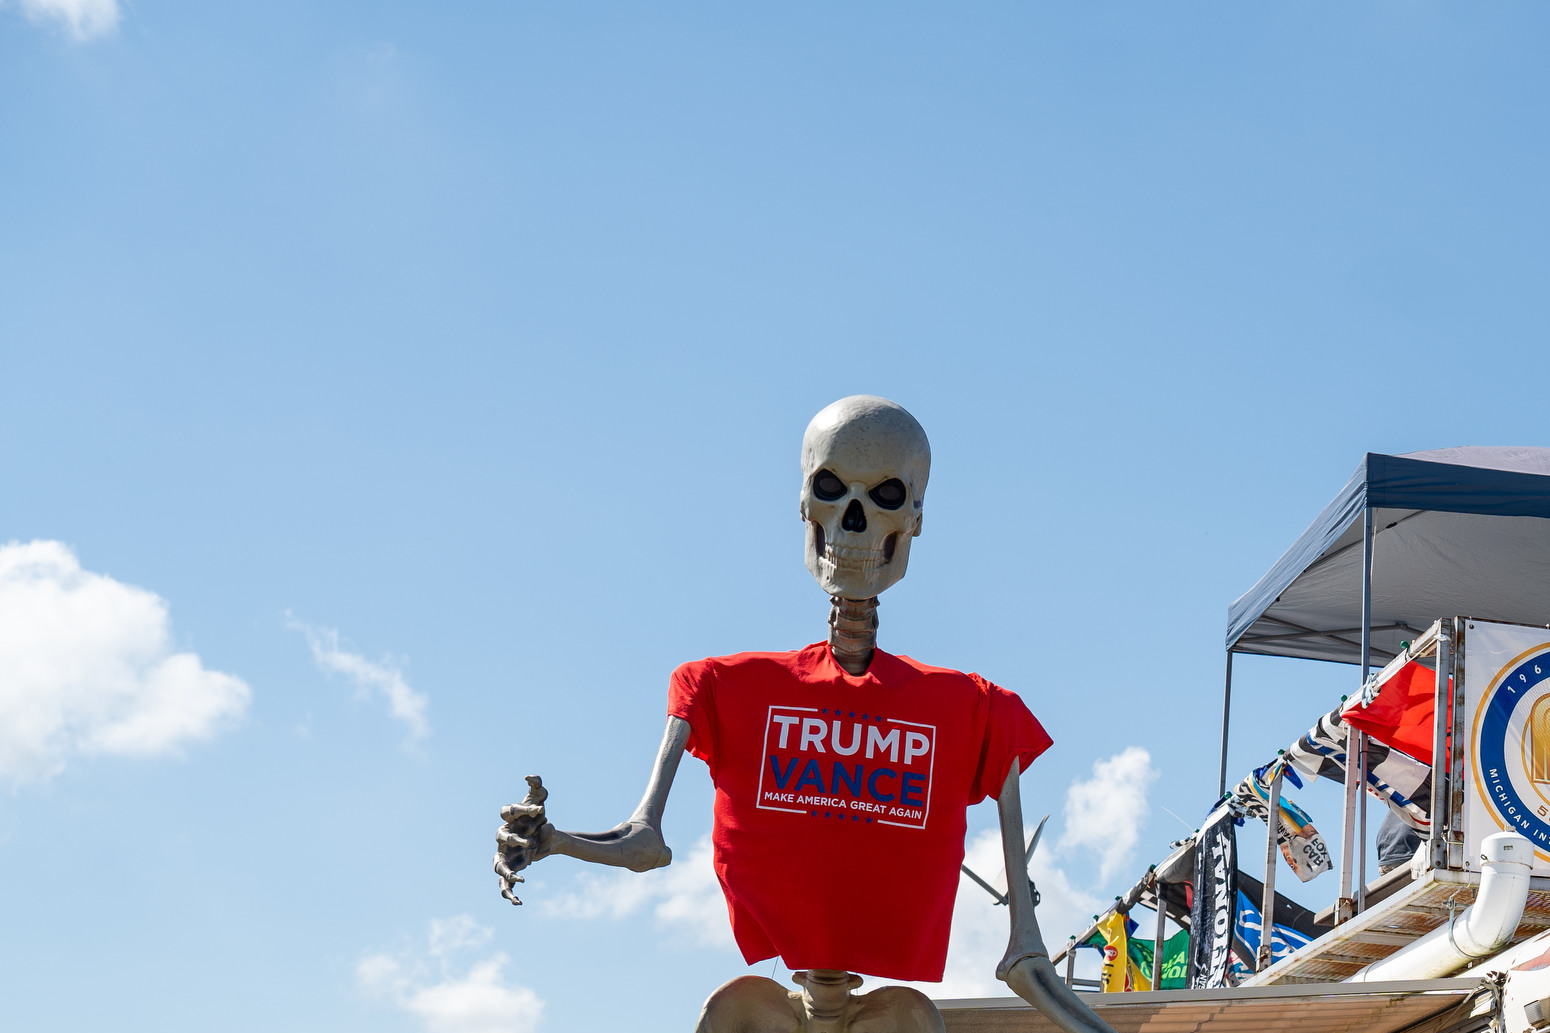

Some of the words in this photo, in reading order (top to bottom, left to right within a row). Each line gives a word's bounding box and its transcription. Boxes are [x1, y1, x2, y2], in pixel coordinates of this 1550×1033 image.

[773, 715, 930, 765] TRUMP
[764, 791, 794, 803] MAKE
[796, 795, 847, 808] AMERICA
[850, 801, 887, 814] GREAT
[888, 807, 922, 820] AGAIN
[769, 755, 926, 807] VANCE
[1489, 768, 1531, 830] MICHIGAN
